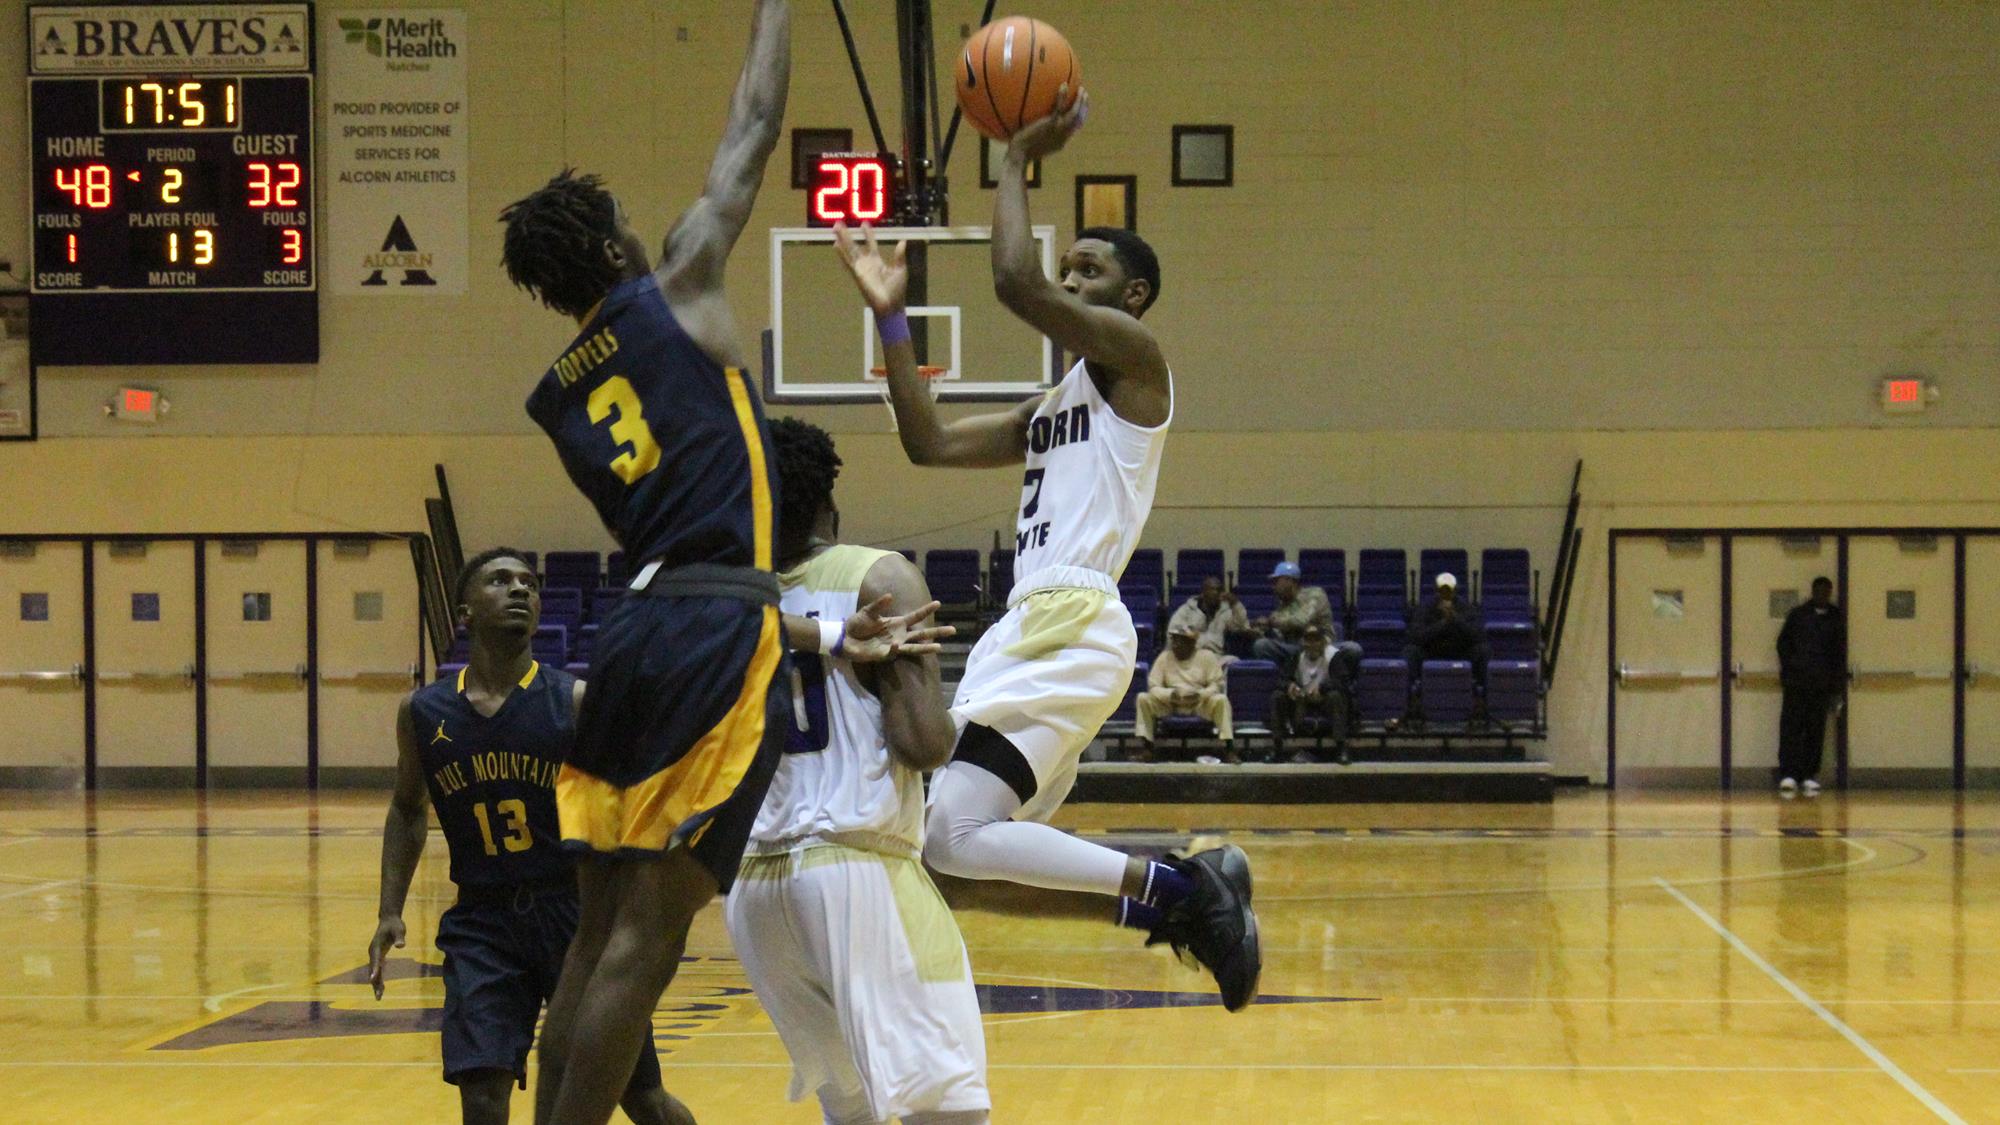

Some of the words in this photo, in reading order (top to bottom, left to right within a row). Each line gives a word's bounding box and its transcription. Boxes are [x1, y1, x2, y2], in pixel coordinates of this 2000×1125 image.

[73, 18, 267, 57] BRAVES
[386, 18, 444, 37] Merit
[386, 37, 457, 58] Health
[124, 82, 235, 127] 17:51
[334, 103, 377, 114] PROUD
[380, 103, 440, 114] PROVIDER
[444, 102, 460, 114] OF
[343, 126, 387, 138] SPORTS
[391, 125, 451, 137] MEDICINE
[47, 136, 105, 158] HOME
[147, 148, 196, 163] PERIOD
[232, 134, 299, 156] GUEST
[355, 149, 411, 160] SERVICES
[415, 149, 440, 160] FOR
[56, 165, 111, 208] 48
[161, 168, 183, 204] 2
[248, 163, 301, 207] 32
[339, 172, 391, 183] ALCORN
[394, 171, 456, 183] ATHLETICS
[817, 162, 884, 219] 20
[37, 214, 81, 228] FOULS
[129, 213, 180, 227] PLAYER
[184, 213, 219, 227] FOUL
[263, 211, 307, 226] FOULS
[67, 233, 77, 263] 1
[282, 228, 301, 263] 3
[362, 253, 433, 268] ALCORN
[38, 272, 83, 287] SCORE
[149, 271, 197, 286] MATCH
[263, 269, 307, 285] SCORE
[553, 326, 619, 389] TOPPERS
[586, 375, 662, 485] 3
[1027, 403, 1090, 455] ORN
[472, 751, 562, 791] MOUNTAIN
[473, 798, 535, 857] 13
